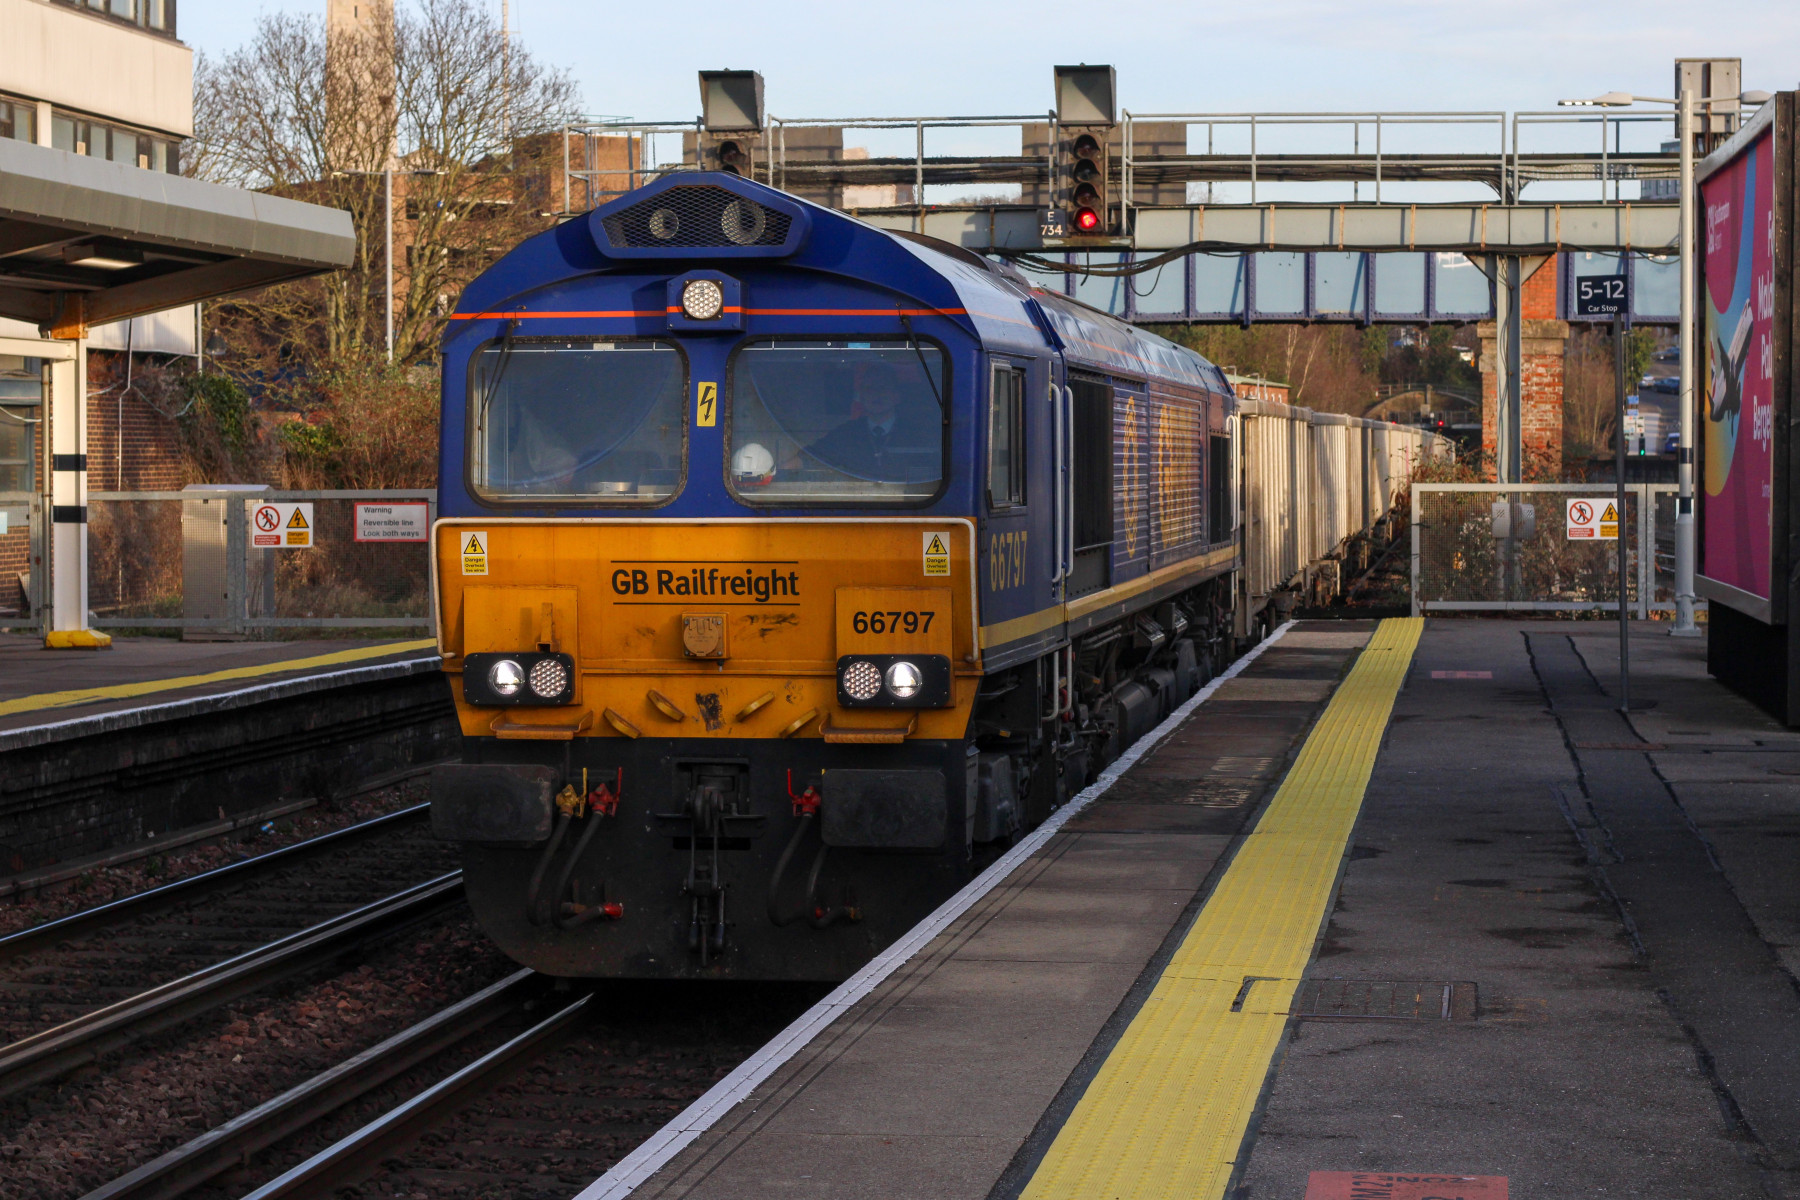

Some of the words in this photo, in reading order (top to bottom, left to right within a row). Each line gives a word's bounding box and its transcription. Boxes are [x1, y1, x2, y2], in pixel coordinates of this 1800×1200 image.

[1047, 211, 1055, 222] E
[1041, 224, 1063, 236] 734
[1580, 280, 1625, 299] 5-12
[1602, 304, 1618, 312] Stop
[990, 531, 1028, 592] 66797
[611, 569, 649, 595] GB
[657, 568, 800, 602] Railfreight
[853, 611, 935, 634] 66797
